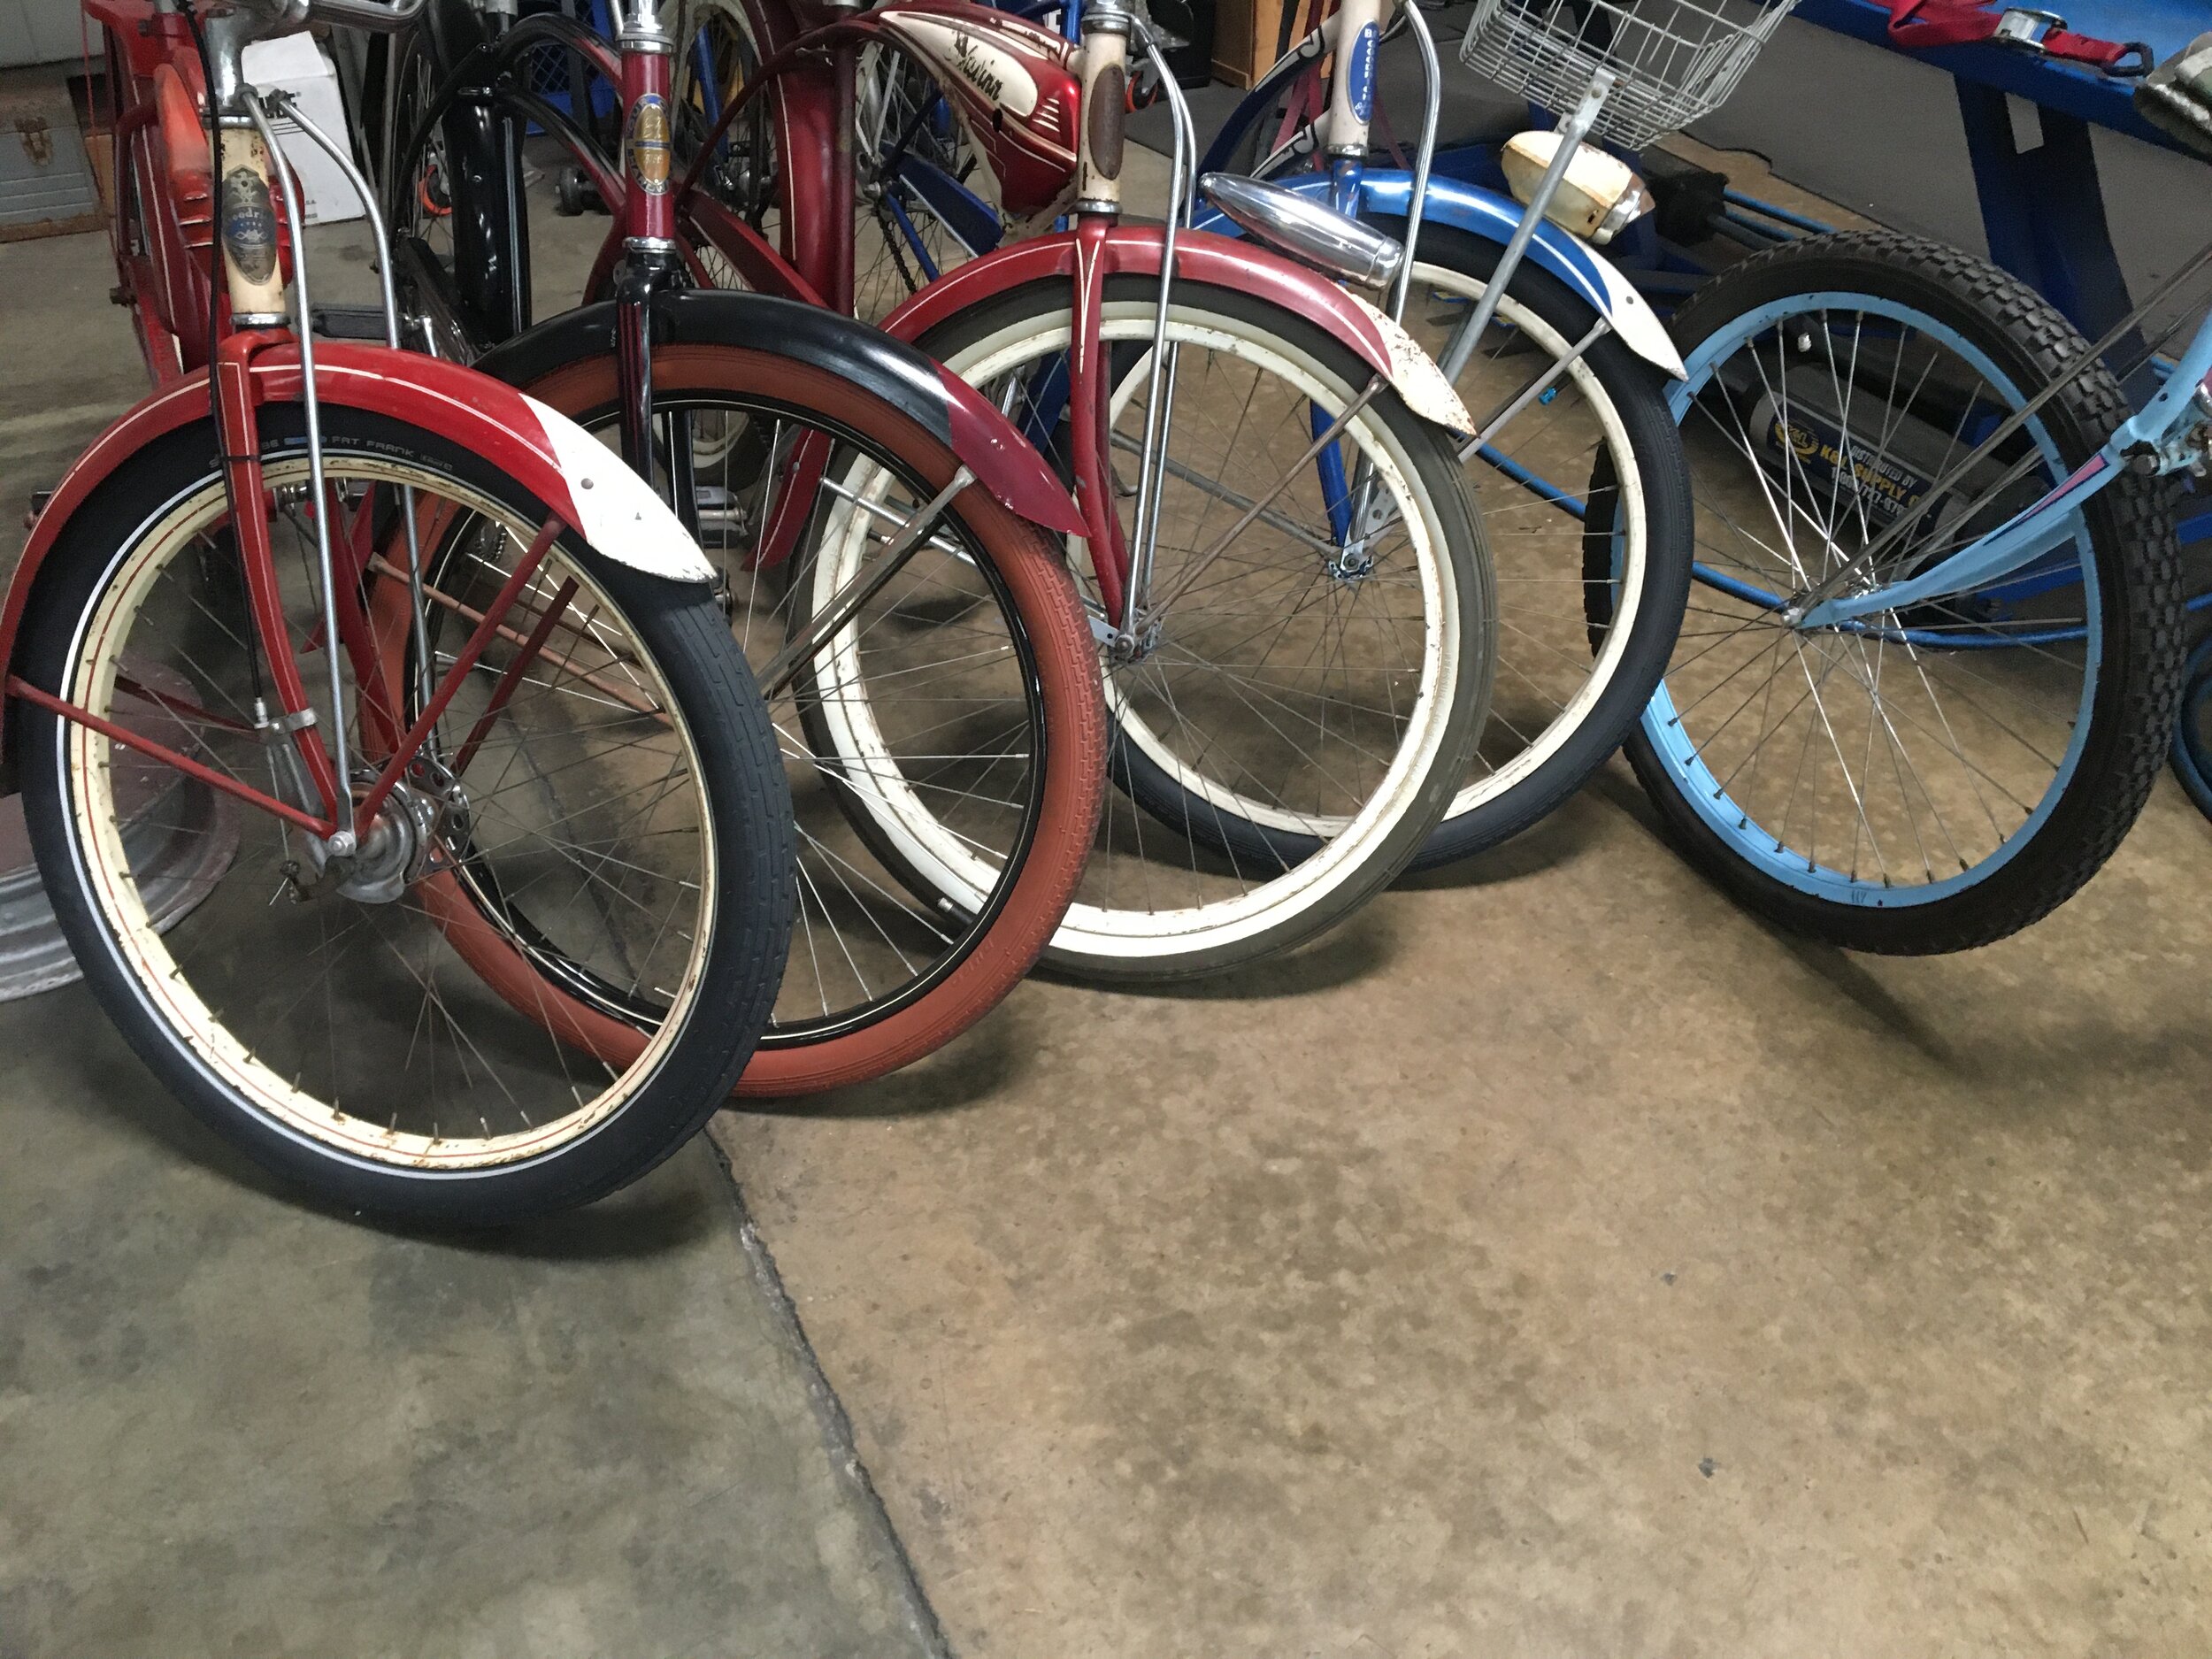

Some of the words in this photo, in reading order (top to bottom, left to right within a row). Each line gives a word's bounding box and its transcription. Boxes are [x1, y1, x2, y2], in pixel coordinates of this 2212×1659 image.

[332, 435, 359, 445] FAT
[1851, 445, 1903, 481] DISTRBUTED
[1855, 463, 1907, 501] SUPPLY
